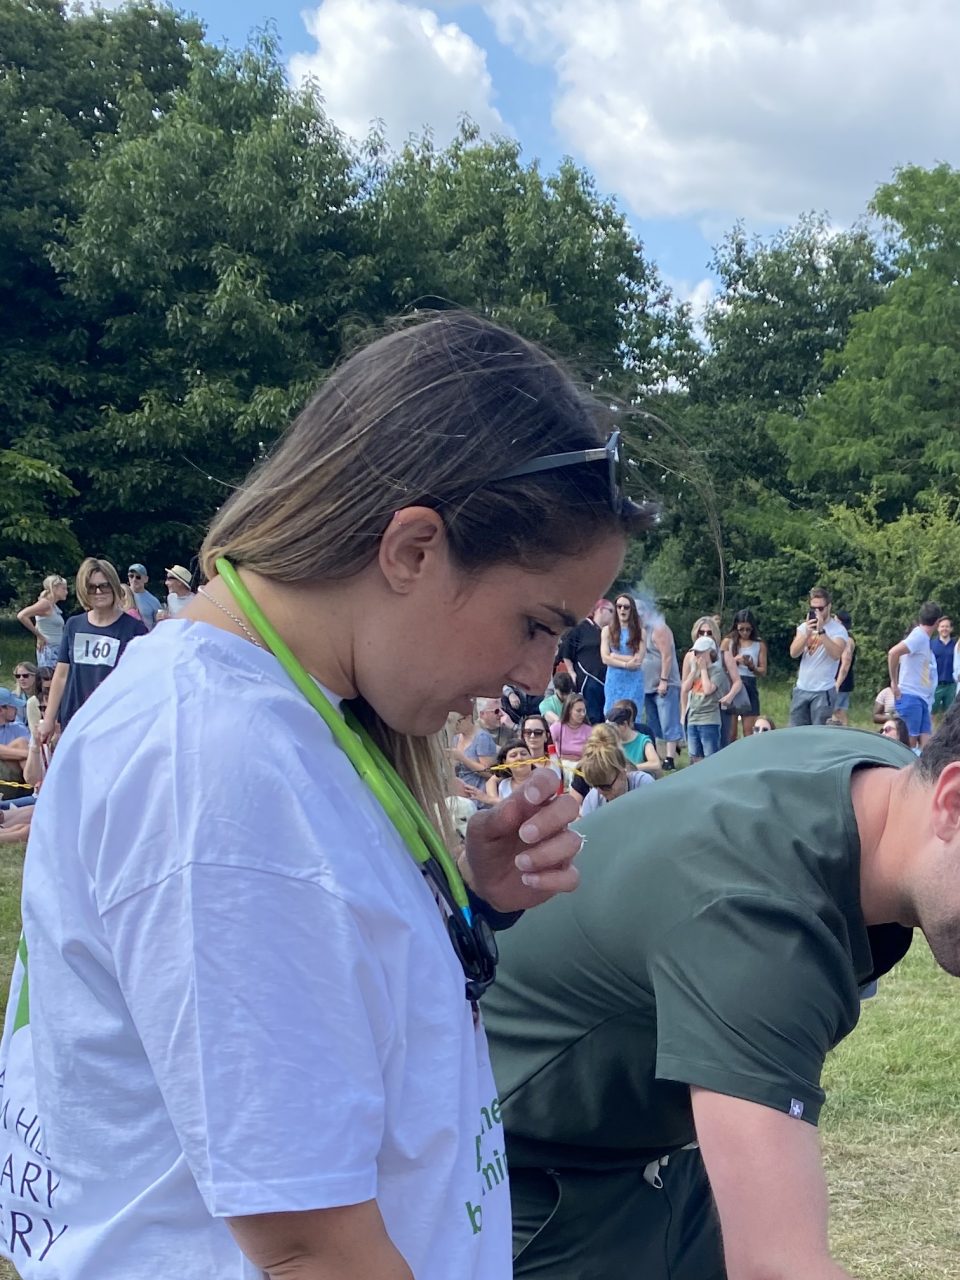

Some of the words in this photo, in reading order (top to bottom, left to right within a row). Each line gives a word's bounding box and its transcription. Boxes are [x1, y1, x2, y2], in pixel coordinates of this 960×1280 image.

[85, 640, 111, 659] 160
[0, 1153, 62, 1208] ARY
[0, 1204, 68, 1261] RY
